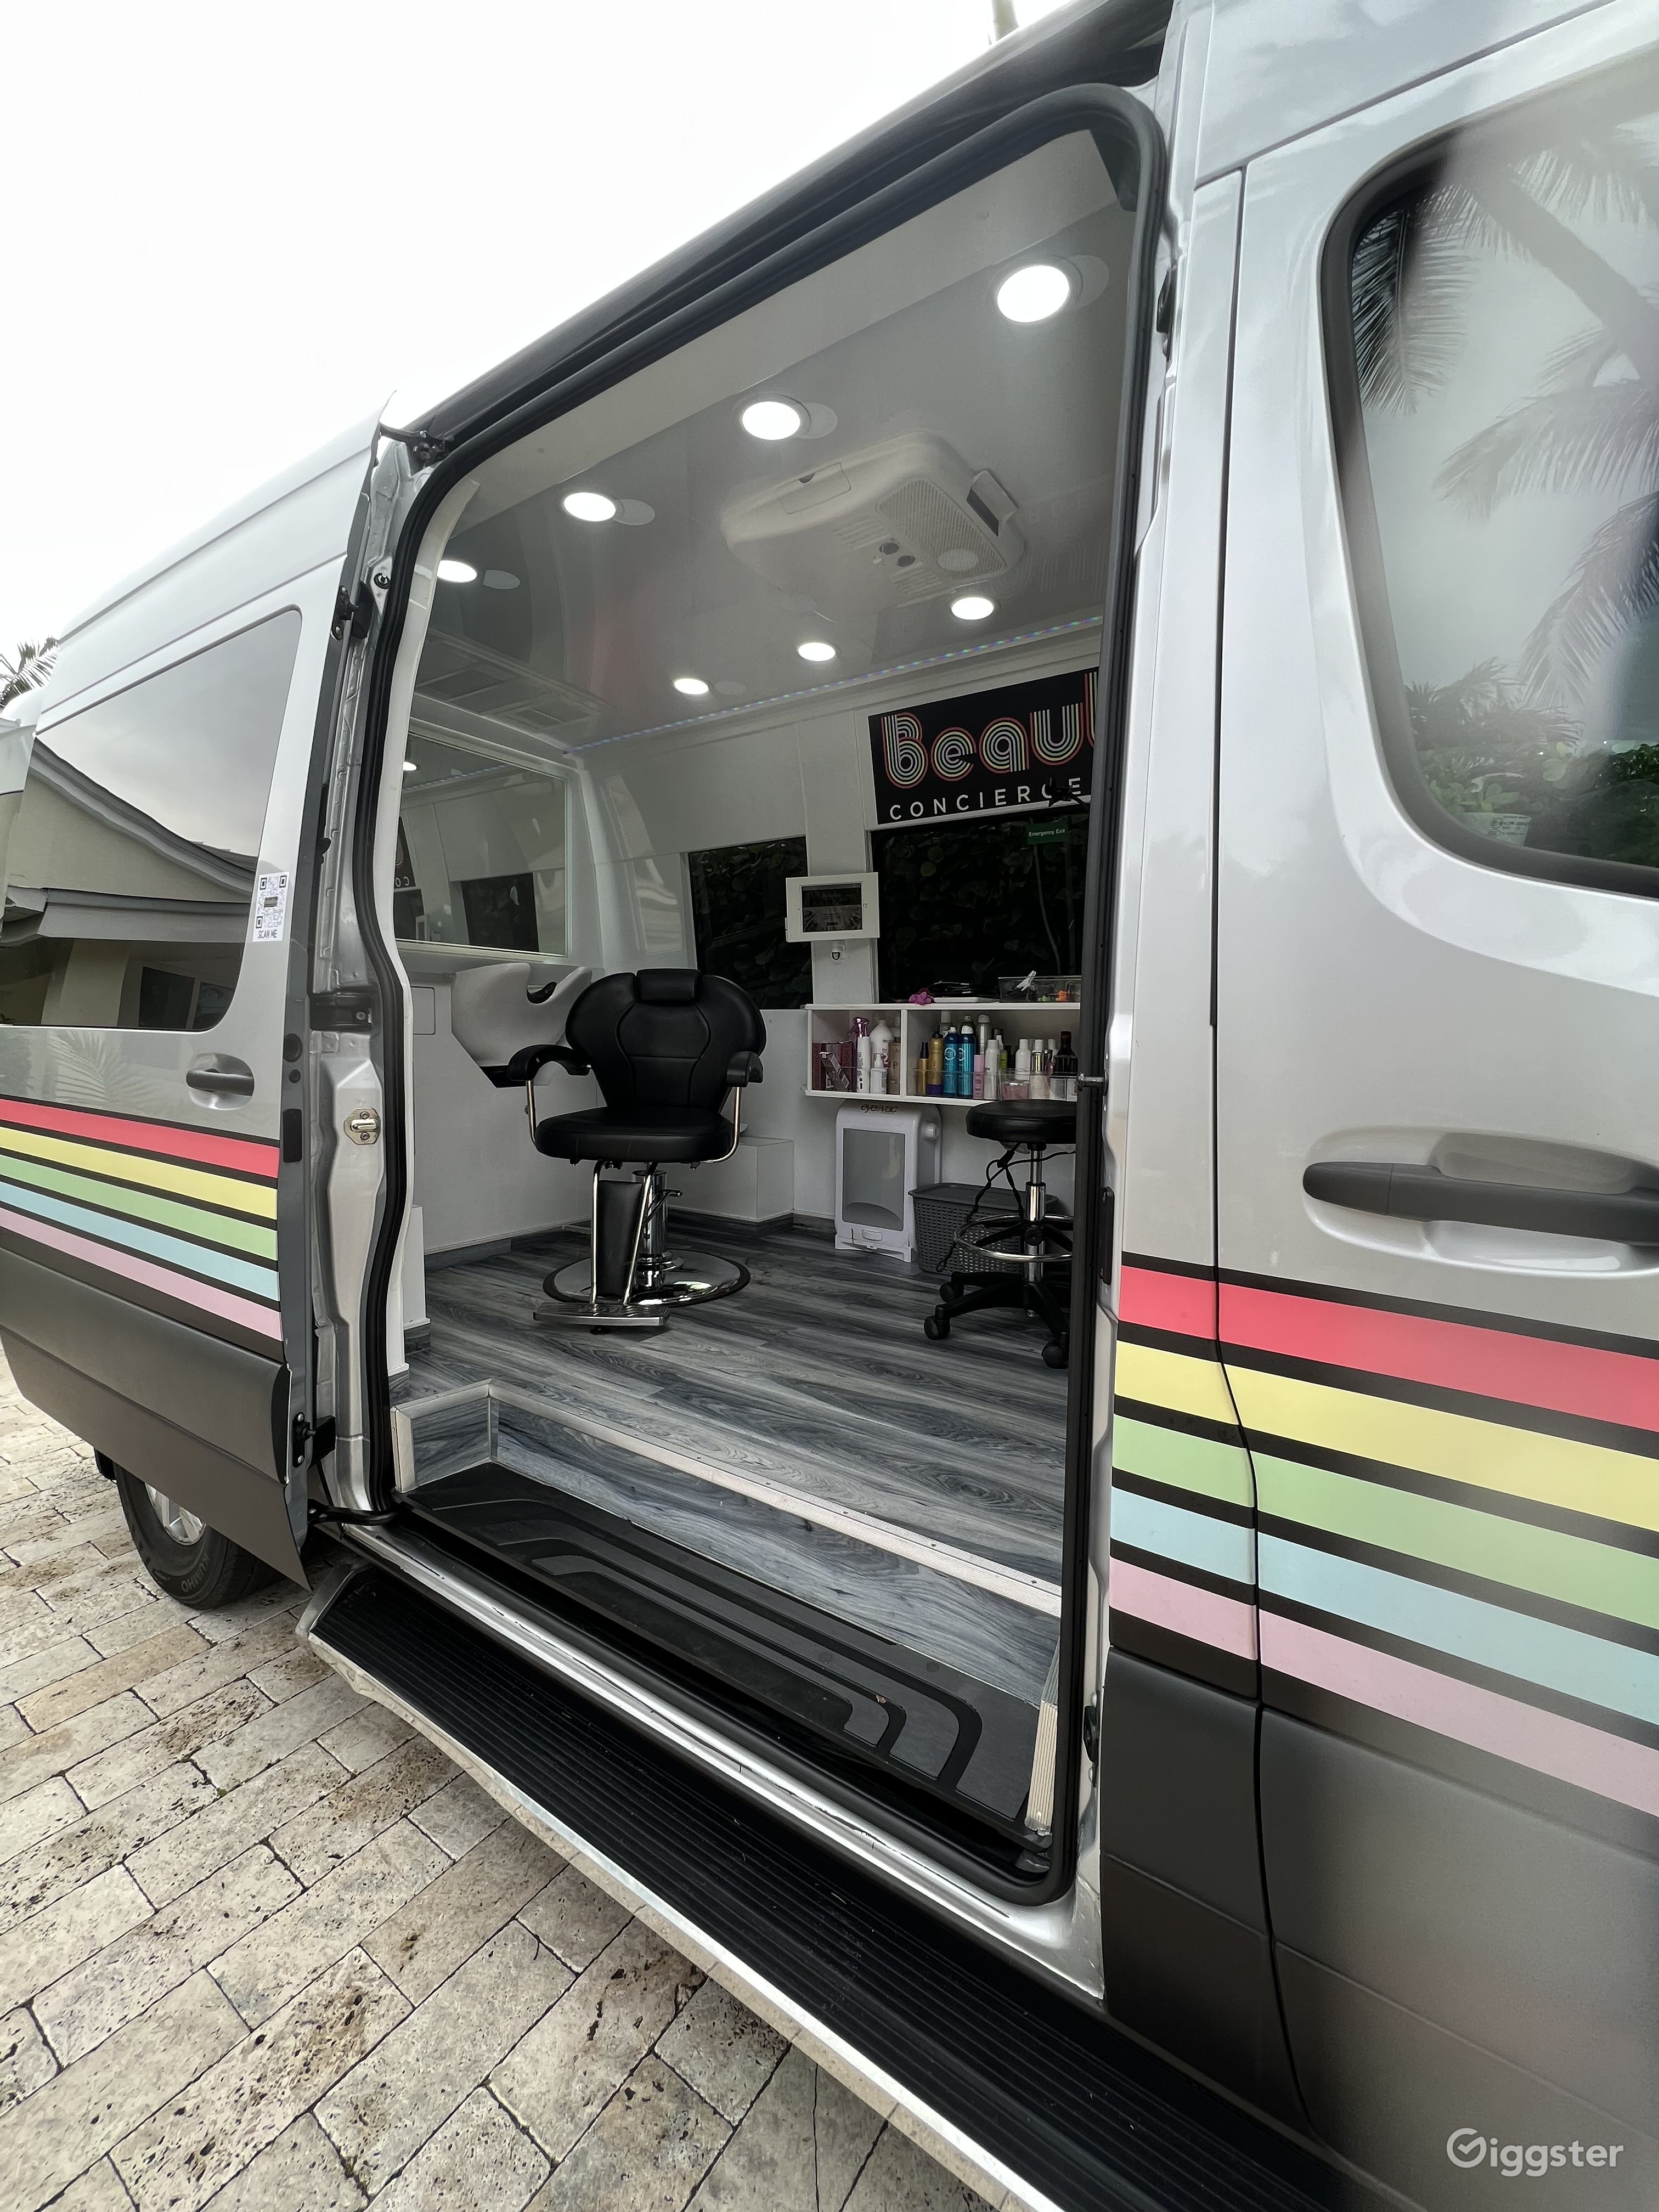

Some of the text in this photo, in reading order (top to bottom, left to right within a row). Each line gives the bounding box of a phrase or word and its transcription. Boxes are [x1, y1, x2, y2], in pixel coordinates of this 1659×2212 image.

[258, 929, 278, 939] SCAN ME
[181, 1551, 210, 1593] KUMHO
